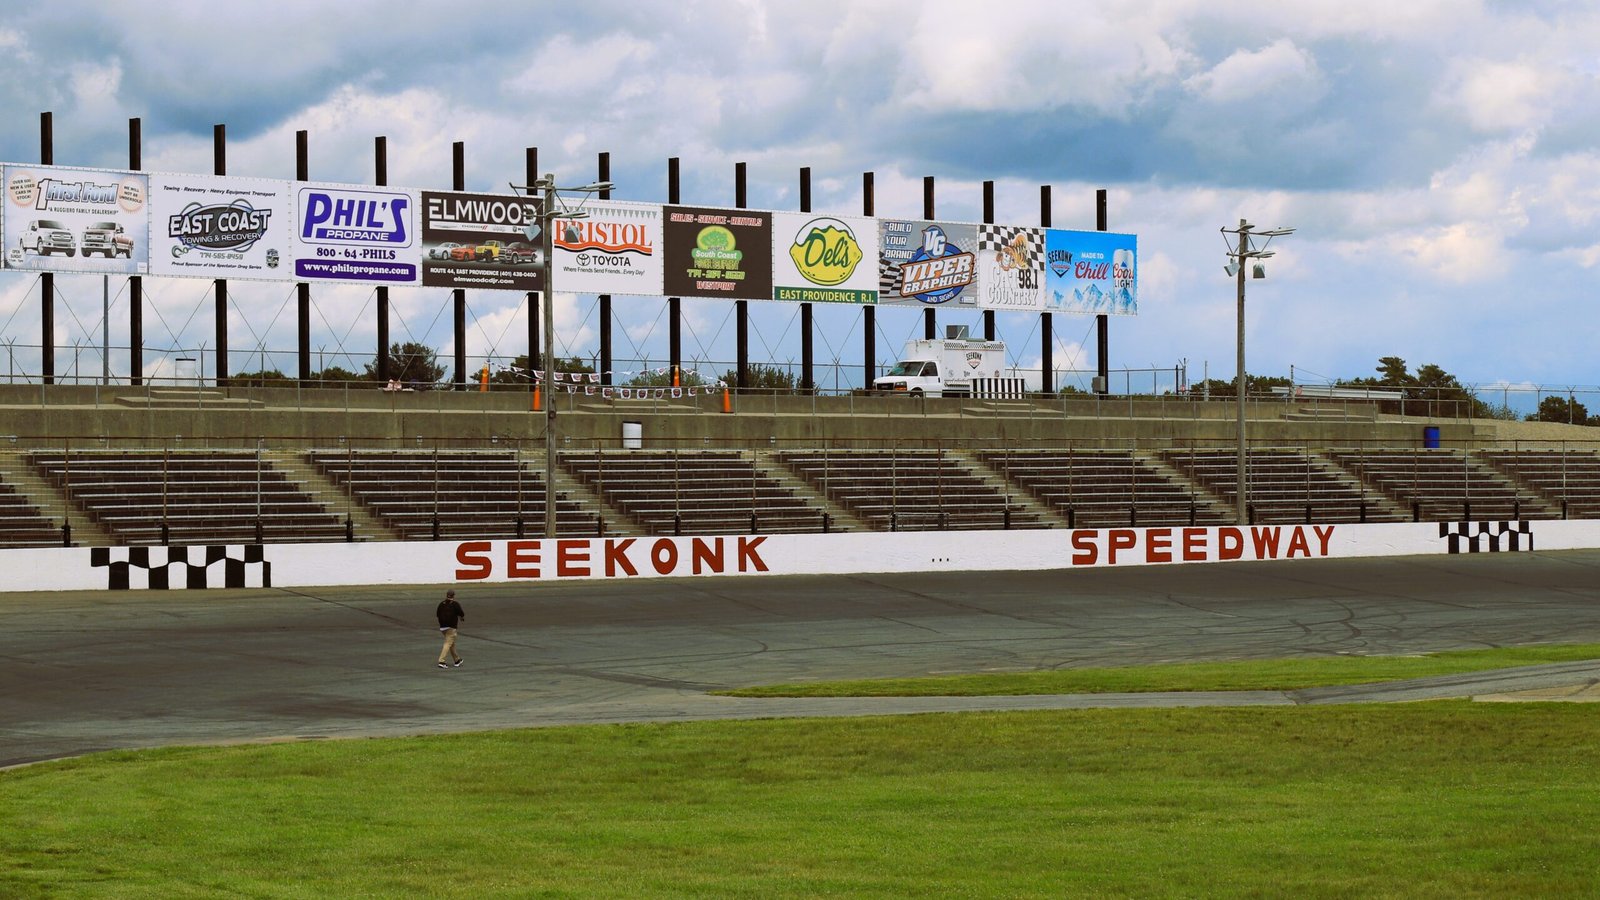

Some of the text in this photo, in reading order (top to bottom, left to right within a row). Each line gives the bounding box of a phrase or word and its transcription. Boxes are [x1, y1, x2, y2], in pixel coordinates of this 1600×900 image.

[46, 180, 82, 202] First
[82, 182, 119, 204] Ford
[302, 193, 407, 242] PHIL'S
[429, 198, 537, 225] ELMWOOD
[169, 210, 271, 236] EAST COAST
[888, 223, 912, 233] BUILD
[182, 235, 213, 244] TOWING
[221, 232, 262, 241] RECOVERY
[326, 230, 389, 241] PROPANE
[886, 236, 907, 246] YOUR
[316, 247, 336, 257] 800
[344, 248, 357, 259] 64
[696, 250, 737, 259] South Coast
[804, 232, 852, 267] Del's
[885, 249, 913, 259] BRAND
[1047, 249, 1073, 265] SEEKONK
[592, 255, 631, 266] TOYOTA
[304, 263, 409, 275] www.philspropane.com
[904, 256, 972, 282] VIPER
[1075, 261, 1110, 280] Chill
[903, 272, 970, 294] GRAPHICS
[1018, 269, 1038, 289] 98.1
[780, 289, 874, 303] EAST PROVIDENCE R.I.
[939, 292, 954, 302] SIGNS
[455, 525, 1335, 580] SEEKONK SPEEDWAY
